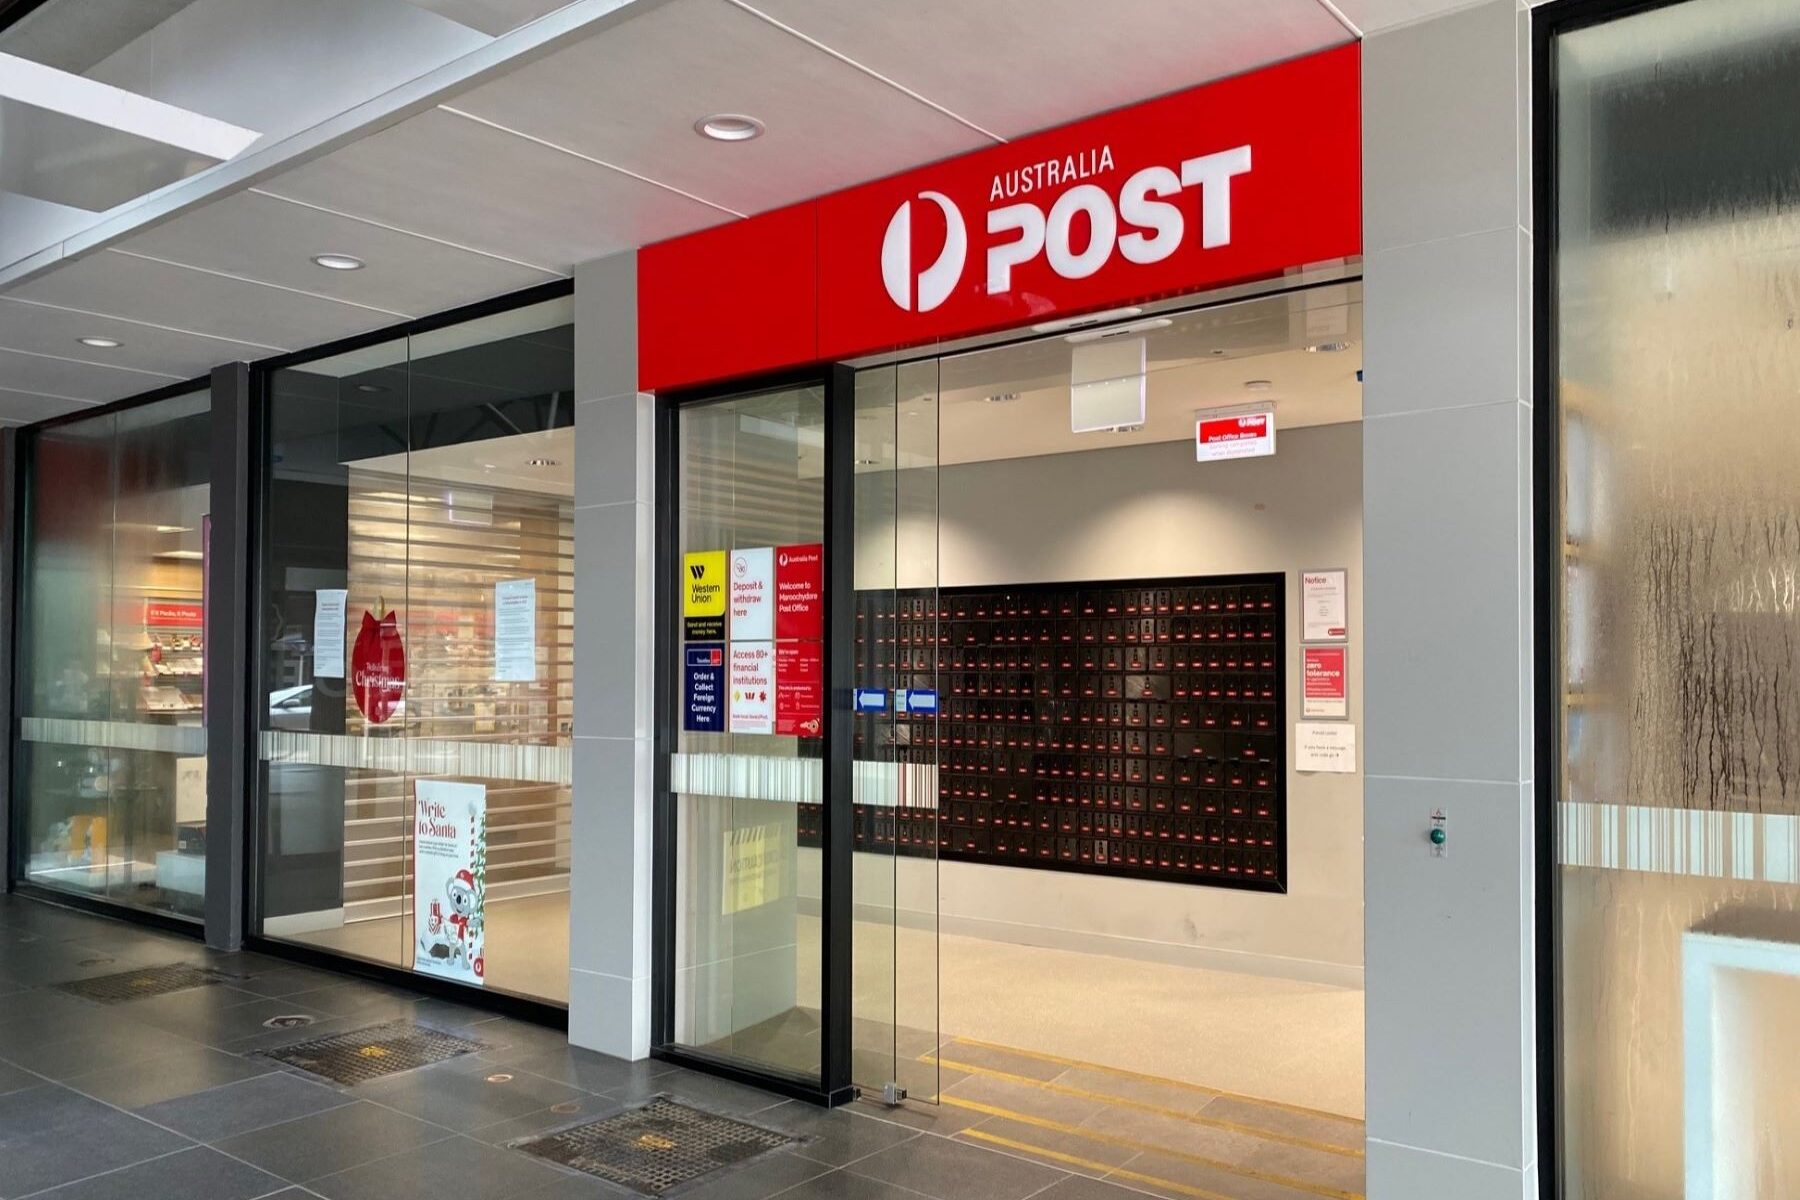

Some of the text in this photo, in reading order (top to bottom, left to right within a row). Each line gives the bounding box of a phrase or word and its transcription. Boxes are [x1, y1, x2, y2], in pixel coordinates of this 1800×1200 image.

[990, 145, 1114, 201] AUSTRALIA
[987, 144, 1252, 296] POST
[1305, 576, 1326, 584] Notice
[692, 584, 720, 593] Western
[734, 581, 763, 592] Deposit &
[779, 582, 804, 590] Welcome
[692, 594, 711, 603] Union
[734, 594, 761, 603] withdraw
[779, 593, 818, 602] Maroochydore
[734, 608, 747, 616] here
[792, 604, 809, 612] Office
[733, 649, 768, 659] Access 80+
[734, 663, 759, 671] financial
[356, 670, 401, 690] Christmas
[694, 672, 715, 680] Order &
[733, 675, 767, 685] institutions
[695, 683, 714, 691] Collect
[694, 693, 714, 703] Foreign
[691, 704, 716, 713] Currency
[418, 800, 446, 819] Write
[419, 817, 456, 839] to Santa
